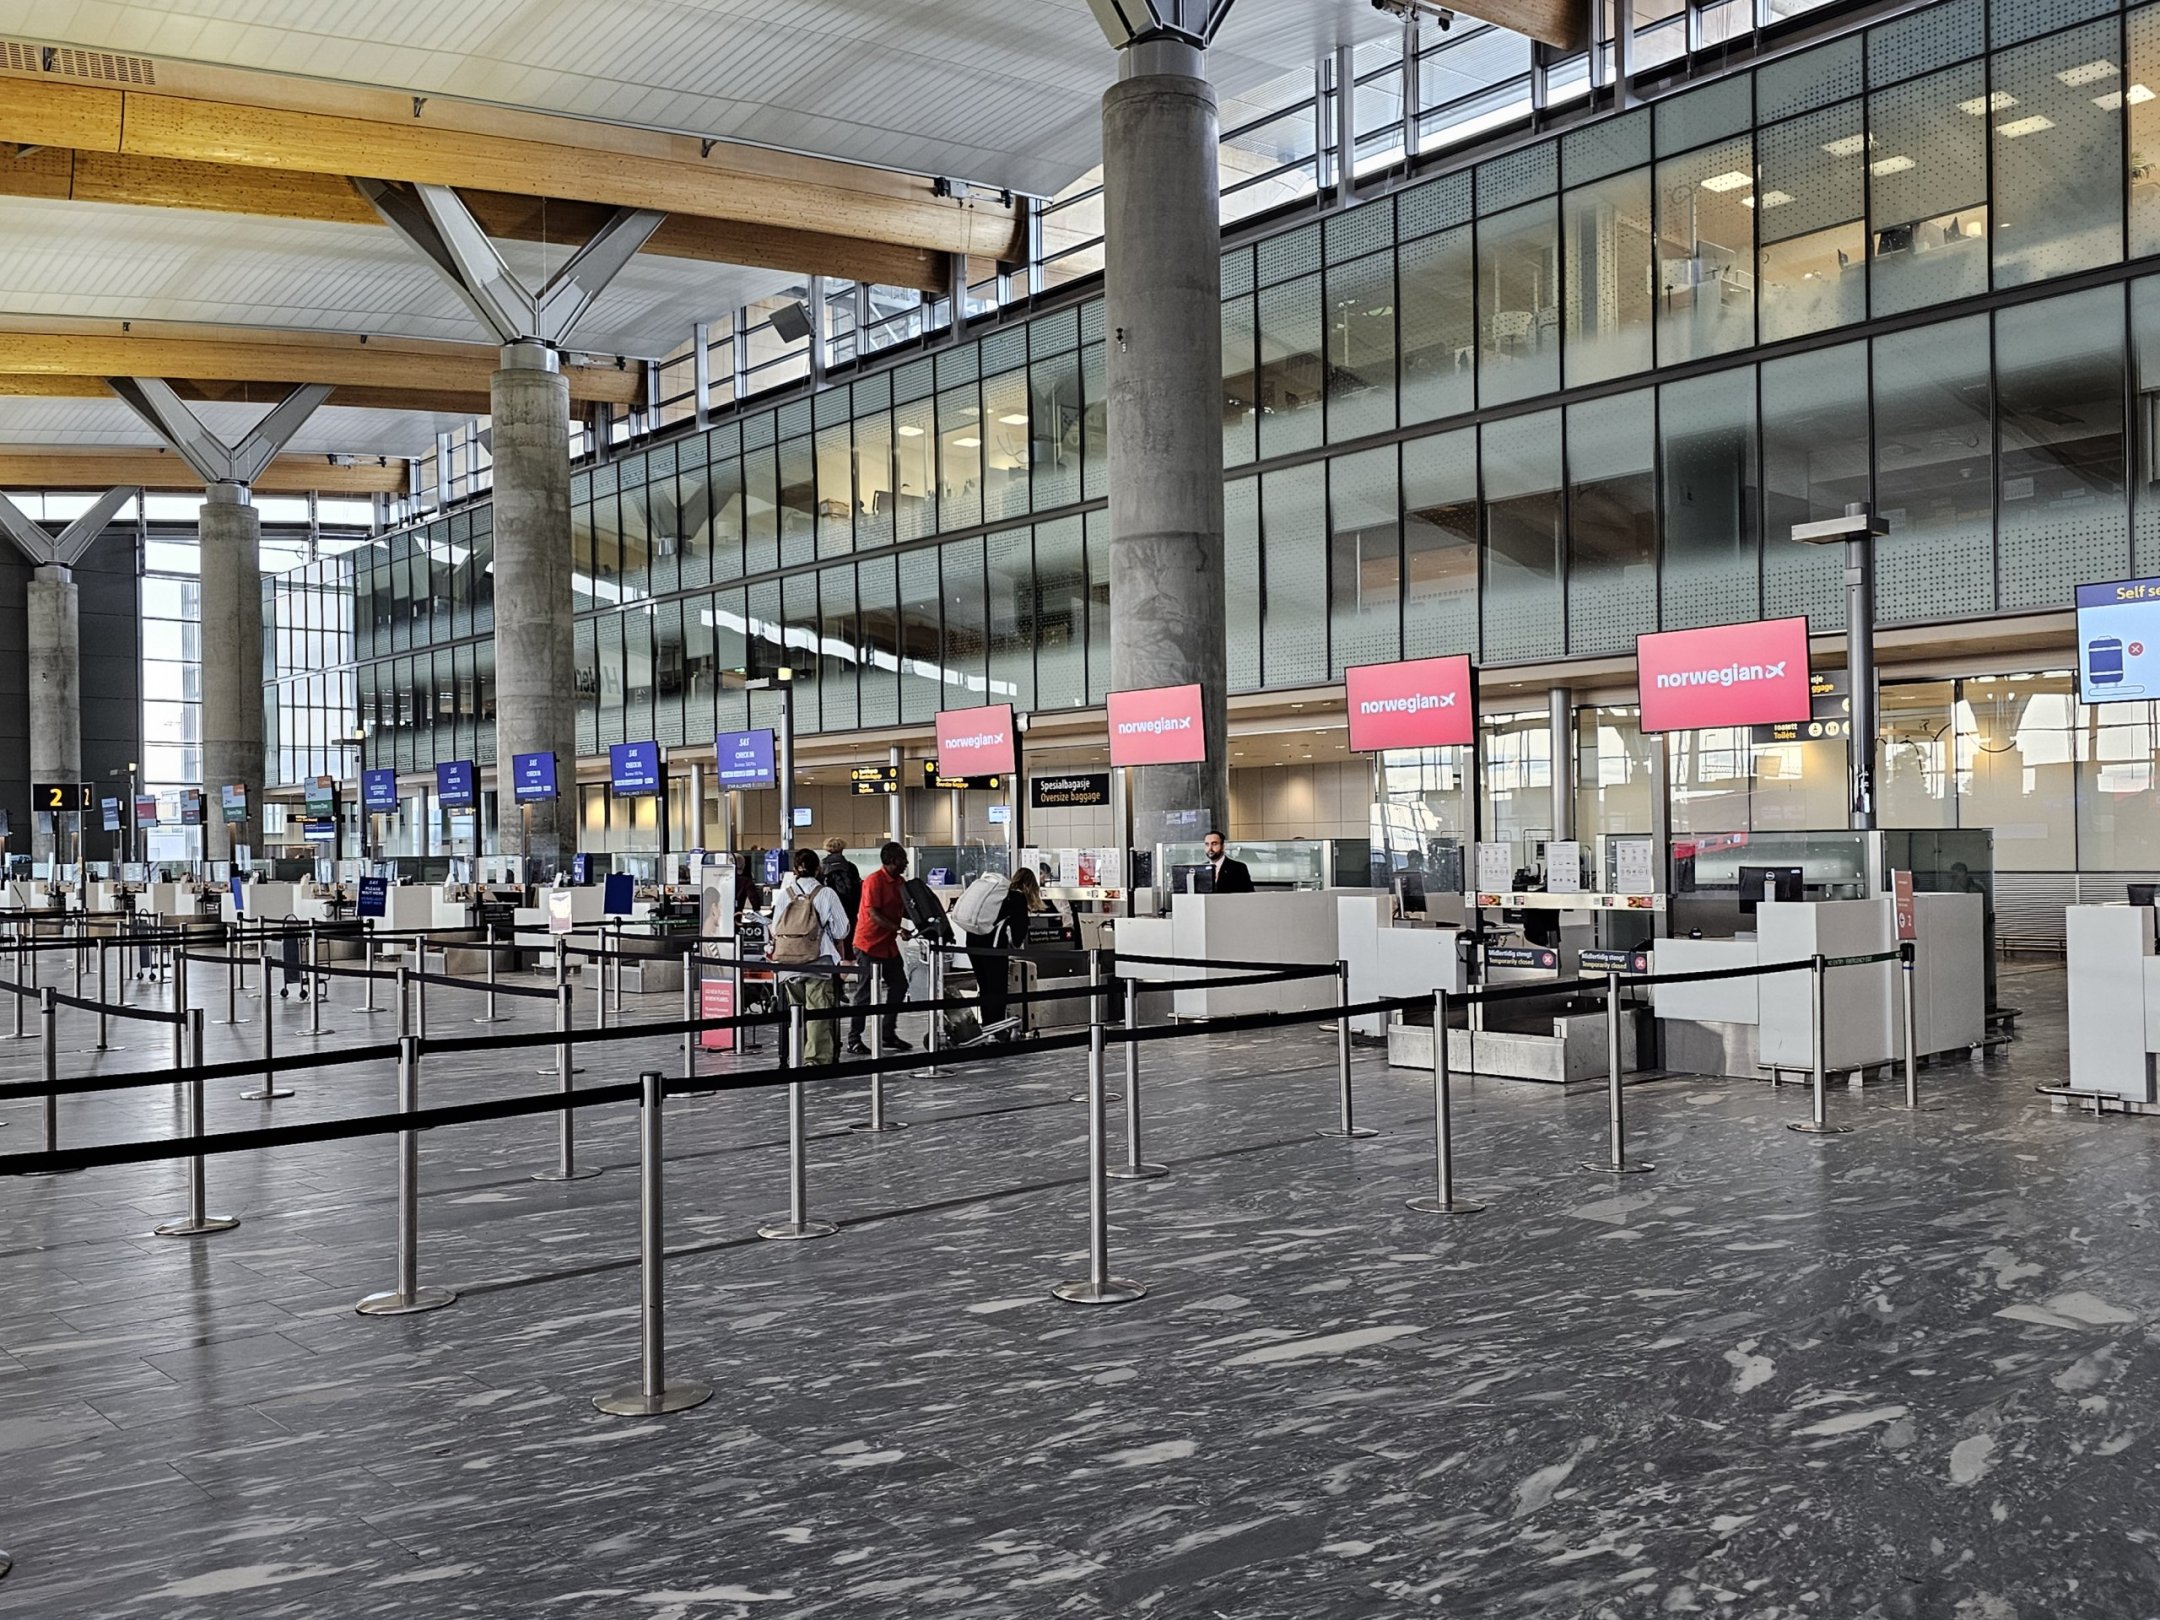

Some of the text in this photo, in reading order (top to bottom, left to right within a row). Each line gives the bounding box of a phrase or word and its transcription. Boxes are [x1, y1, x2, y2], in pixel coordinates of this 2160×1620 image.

[2116, 585, 2146, 600] Self
[1657, 662, 1763, 689] norwegian
[1811, 683, 1835, 694] ggage
[1360, 692, 1439, 714] norwegian
[1118, 716, 1179, 735] norwegian
[944, 732, 994, 749] norwegian
[1773, 731, 1796, 740] Toilets
[1040, 778, 1091, 793] Spesialbagasje
[50, 788, 63, 807] 2
[1040, 790, 1101, 803] Oversize baggage
[1488, 949, 1533, 959] Midlertidig stengt
[1489, 957, 1535, 966] Temporarily closed
[1582, 960, 1628, 970] Temporarily closed
